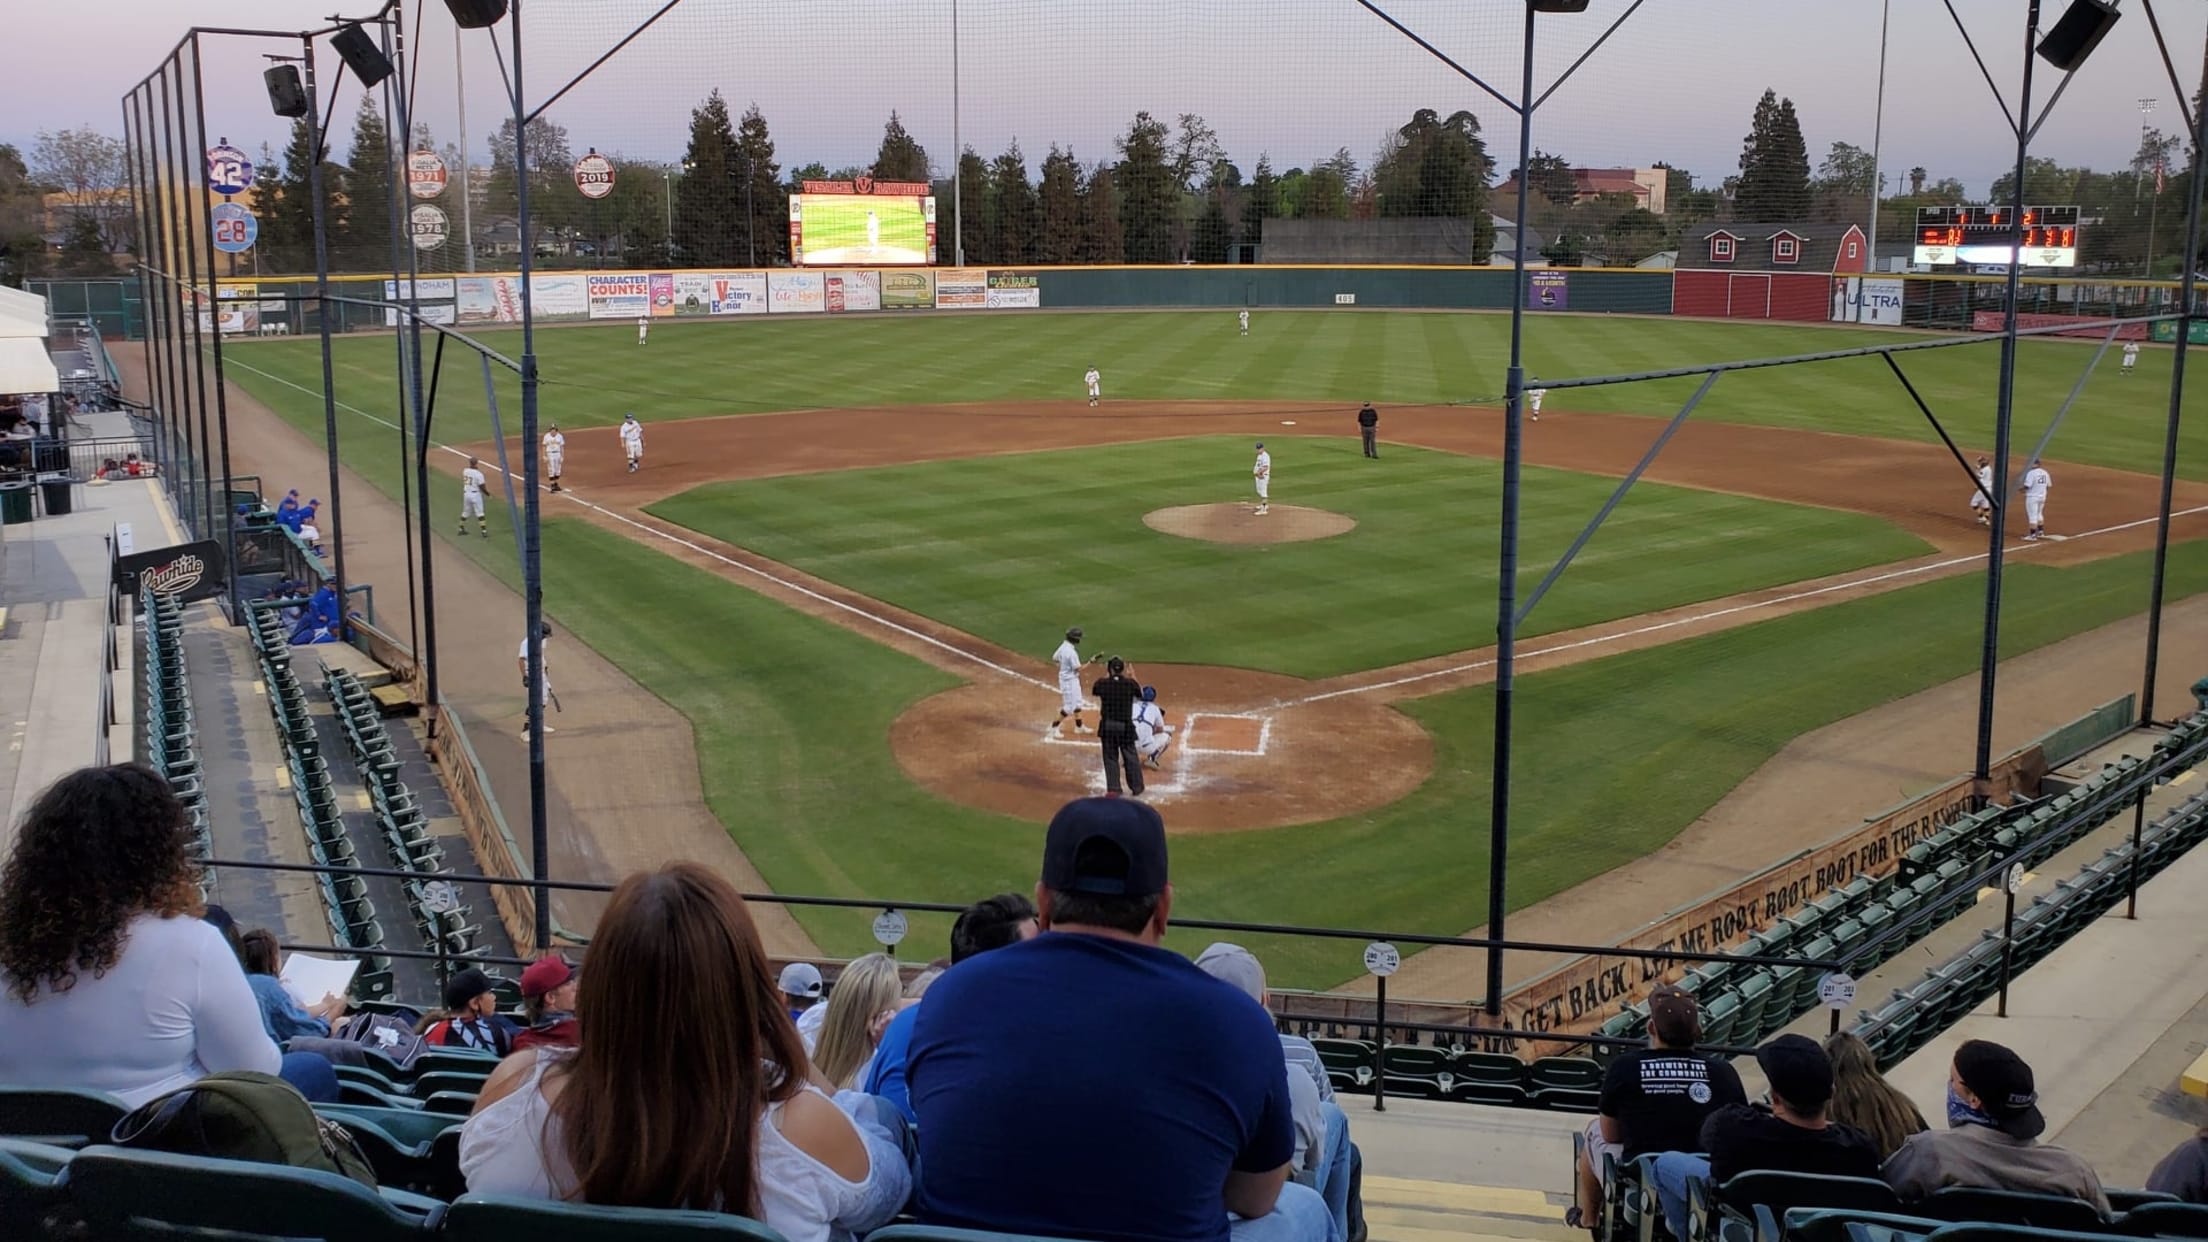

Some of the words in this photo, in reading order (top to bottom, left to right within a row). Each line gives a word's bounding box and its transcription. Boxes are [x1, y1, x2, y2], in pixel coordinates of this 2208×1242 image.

[210, 162, 242, 186] 42
[410, 171, 439, 181] 1971
[580, 173, 609, 183] 2019
[873, 182, 929, 195] RAWHIDE
[2023, 213, 2032, 225] 2
[216, 219, 246, 242] 28
[411, 223, 442, 234] 1978
[400, 281, 450, 290] WNDHAM
[589, 276, 647, 284] CHARACTER
[590, 284, 648, 295] COUNTS!
[715, 280, 752, 302] Victory
[1847, 294, 1901, 309] ULTRA
[140, 554, 204, 602] Rawhide
[1521, 994, 1564, 1042] GET
[1568, 961, 1634, 1021] BACK.
[1641, 938, 1676, 983] LET
[1680, 922, 1708, 956] ME
[1815, 851, 1857, 896] ROOT
[1860, 836, 1888, 871] FOR
[1890, 819, 1919, 856] THE
